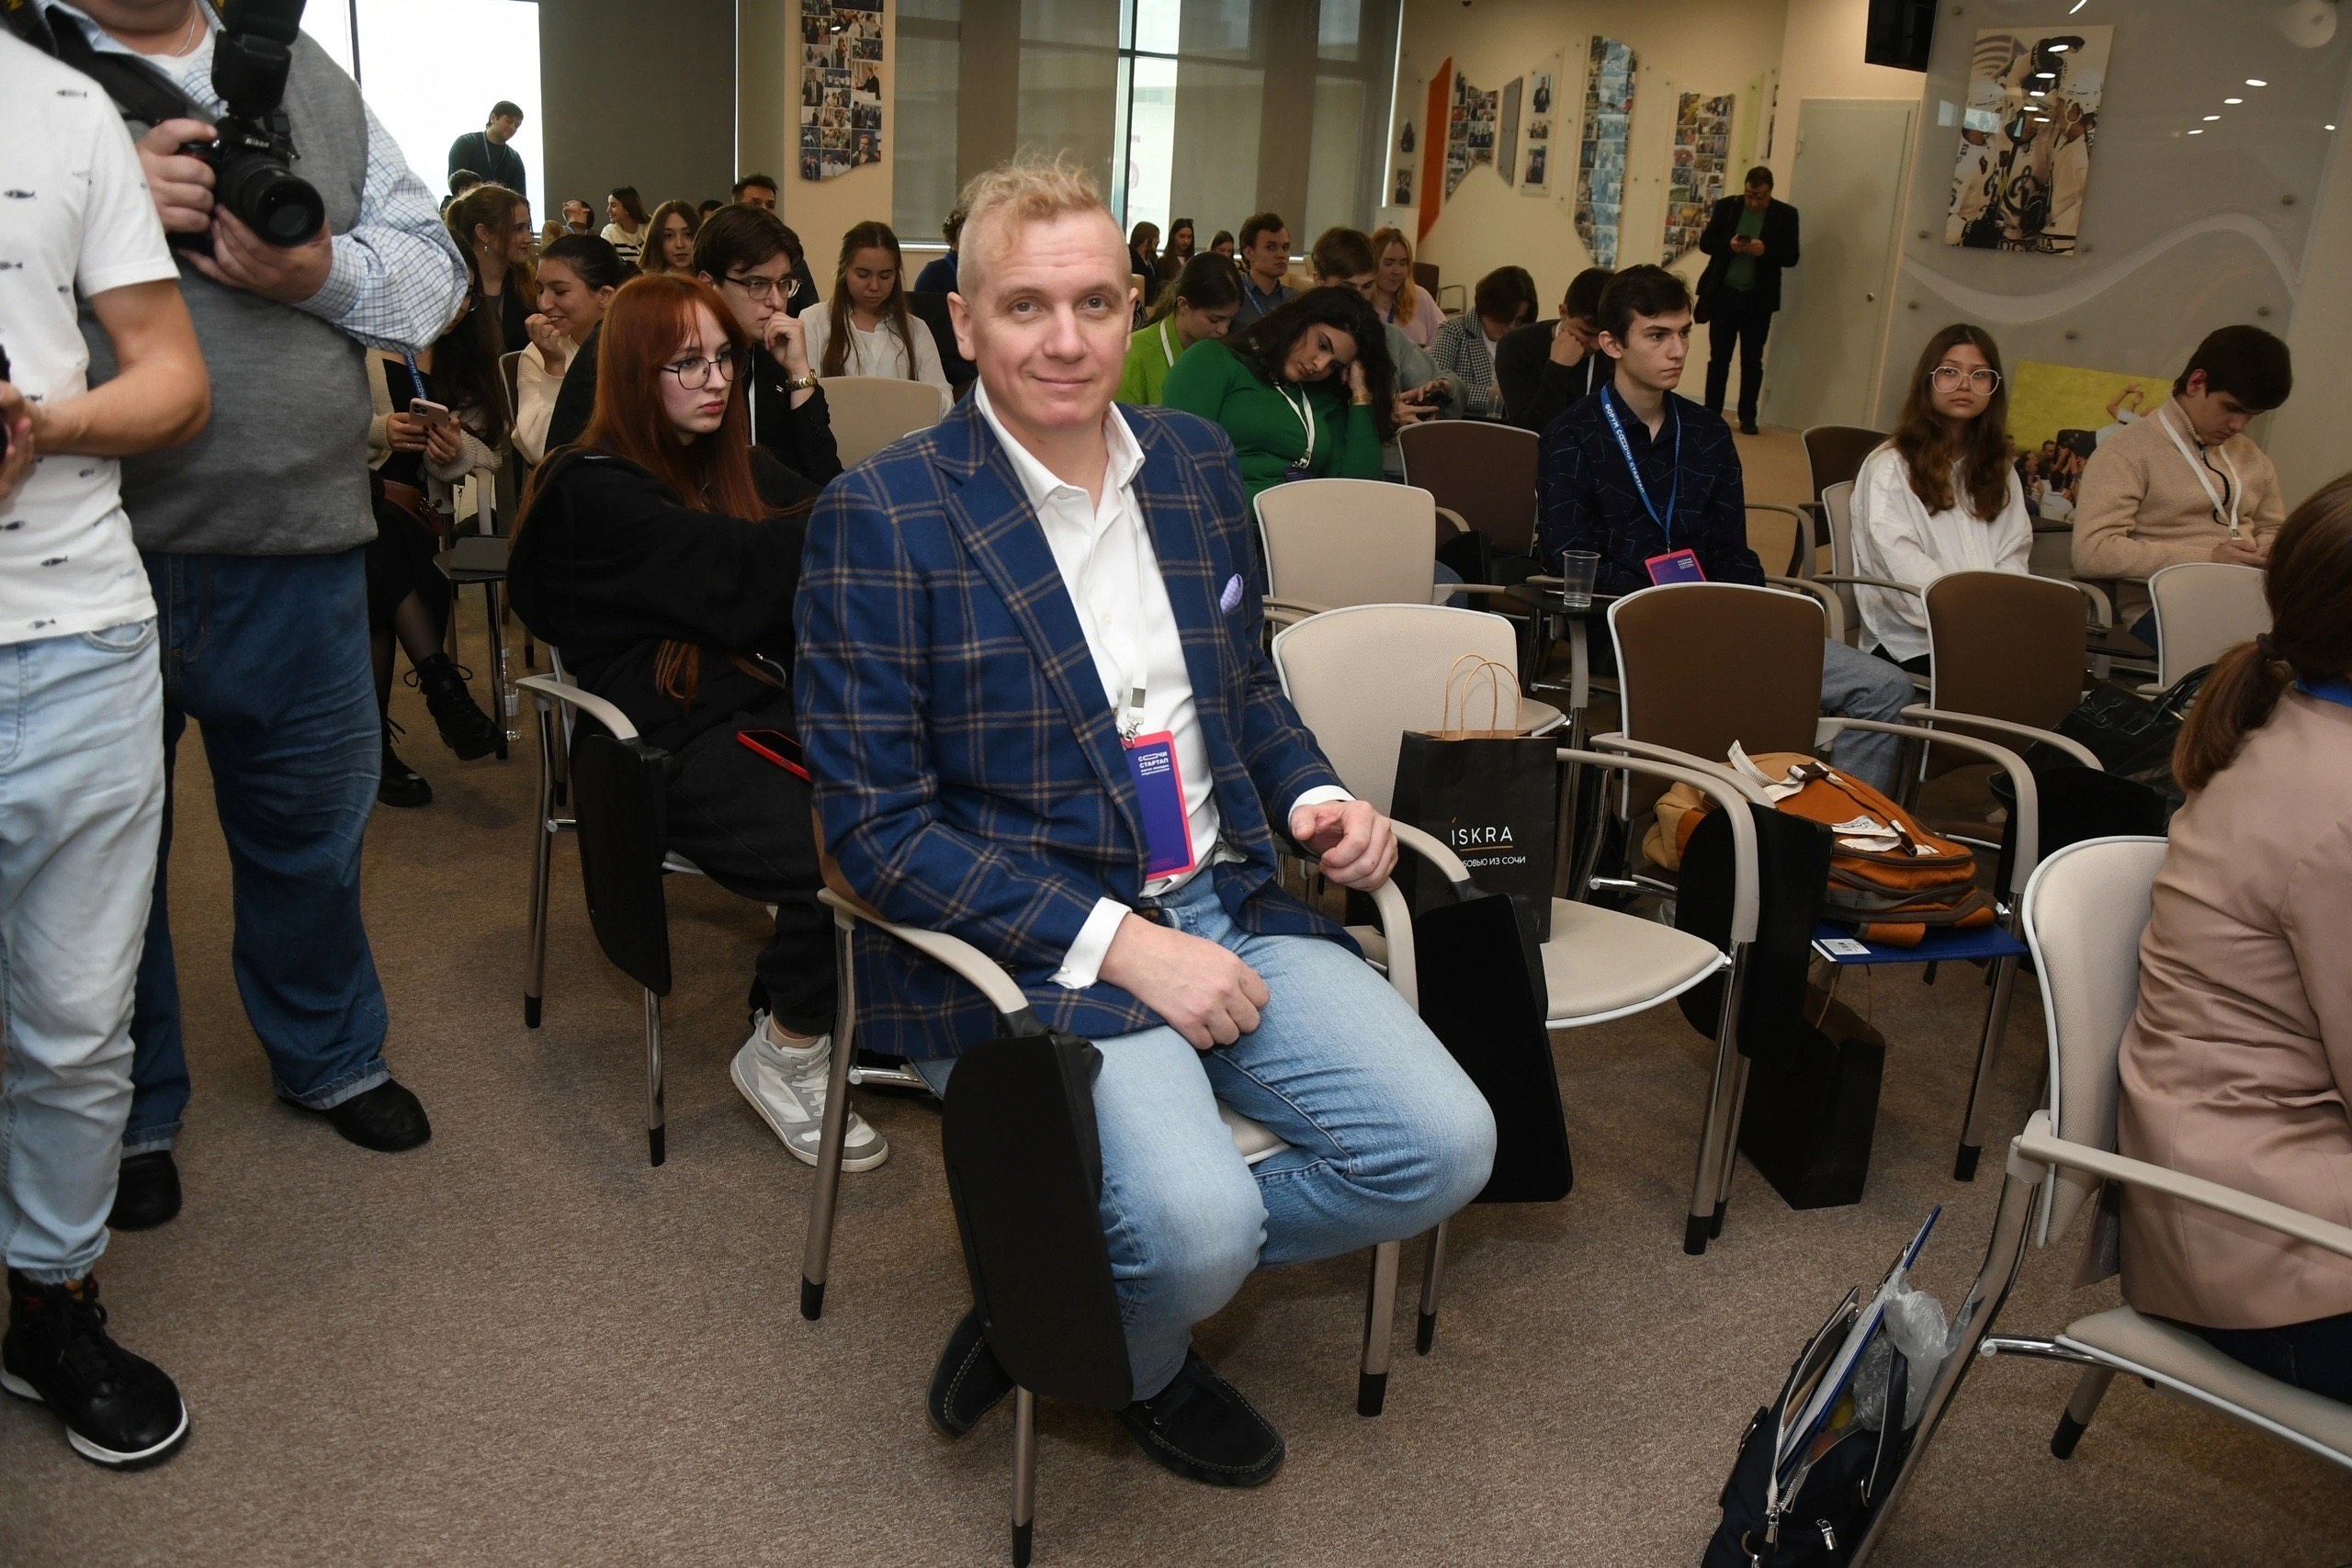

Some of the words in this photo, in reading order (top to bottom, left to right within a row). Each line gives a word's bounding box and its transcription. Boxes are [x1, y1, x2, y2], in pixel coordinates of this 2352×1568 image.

[245, 137, 270, 148] Nikon
[1605, 403, 1620, 429] ФОРУМ
[1616, 429, 1633, 460] СОЧИ
[1629, 461, 1645, 493] СТАРТАП
[1137, 750, 1168, 762] СОЧИ
[1139, 757, 1169, 769] СТАРТАП
[1451, 826, 1513, 846] ISKRA
[1463, 858, 1488, 868] БОВЬЮ
[1488, 857, 1500, 865] ИЗ
[1501, 855, 1526, 865] СОЧИ
